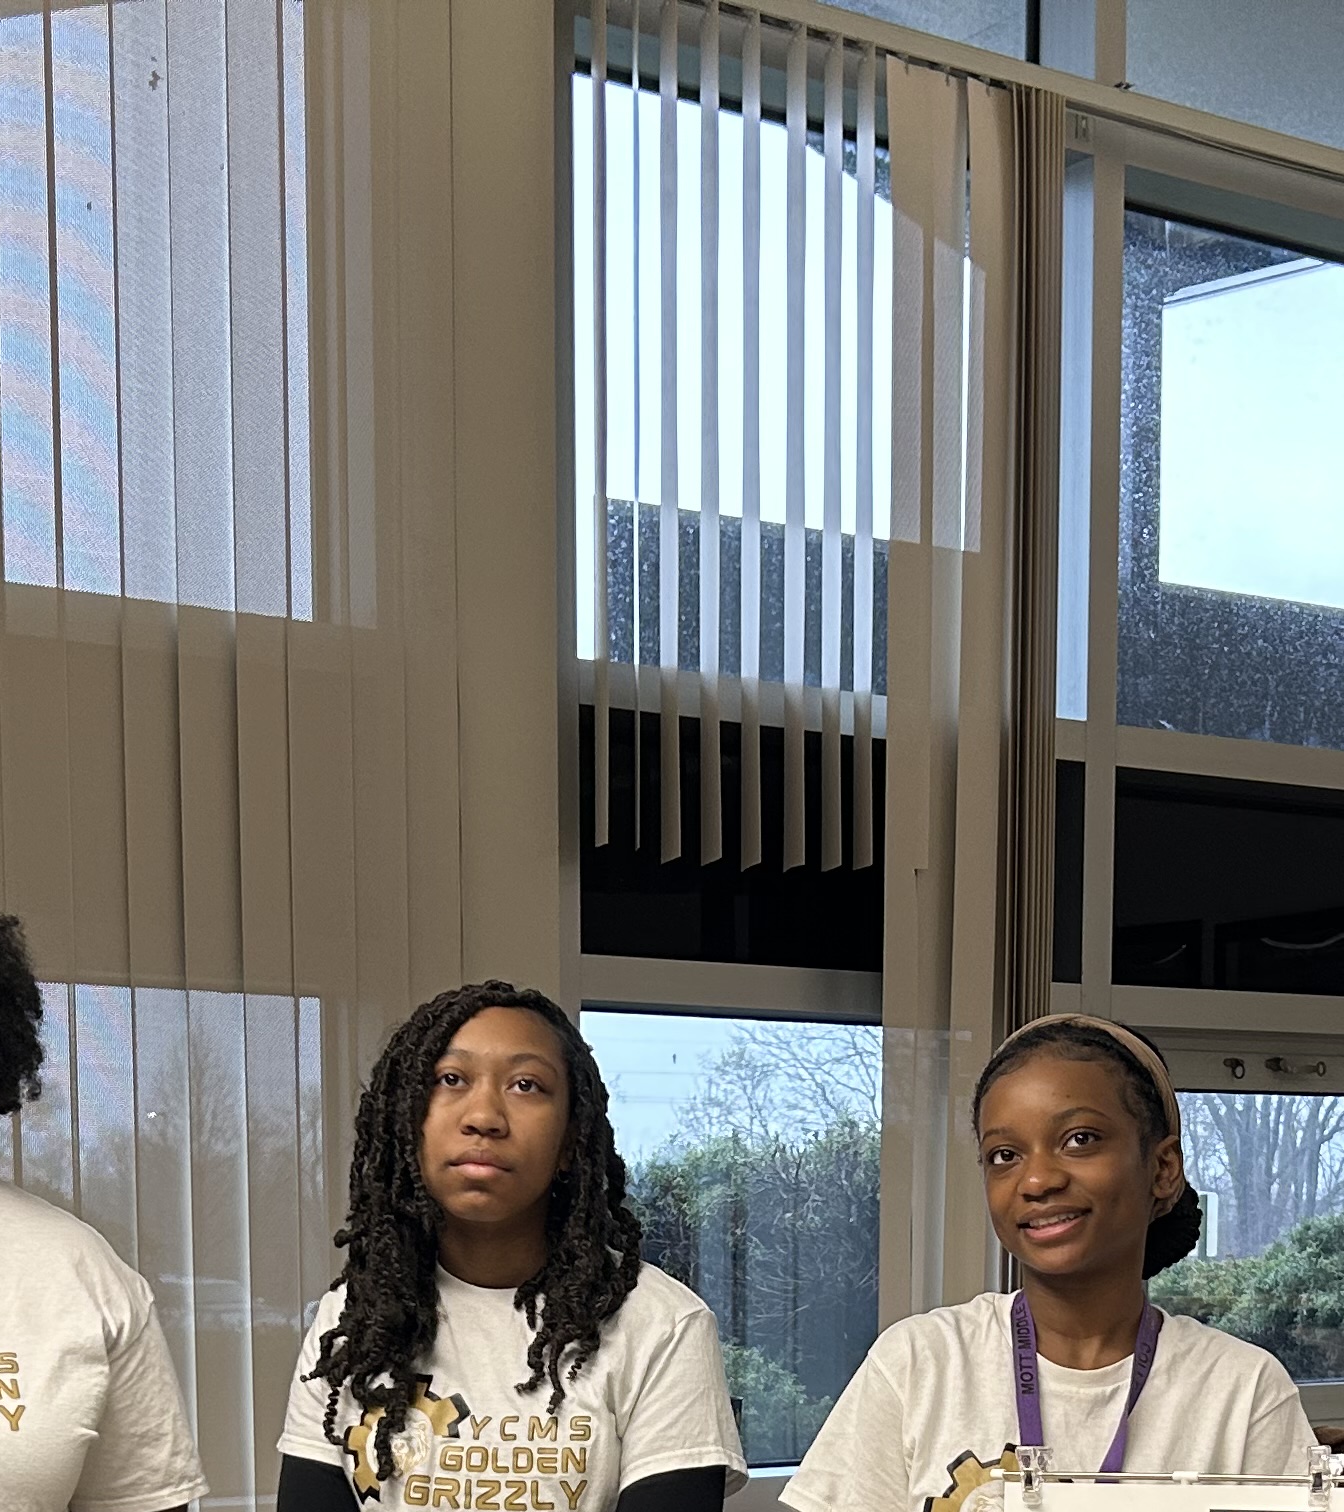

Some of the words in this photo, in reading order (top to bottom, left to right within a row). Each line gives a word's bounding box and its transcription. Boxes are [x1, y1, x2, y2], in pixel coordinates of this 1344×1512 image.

[1015, 1303, 1031, 1350] MIDDLE
[1019, 1354, 1035, 1395] MOTT
[439, 1446, 588, 1473] GOLDEN
[404, 1474, 588, 1511] GRIZZLY
